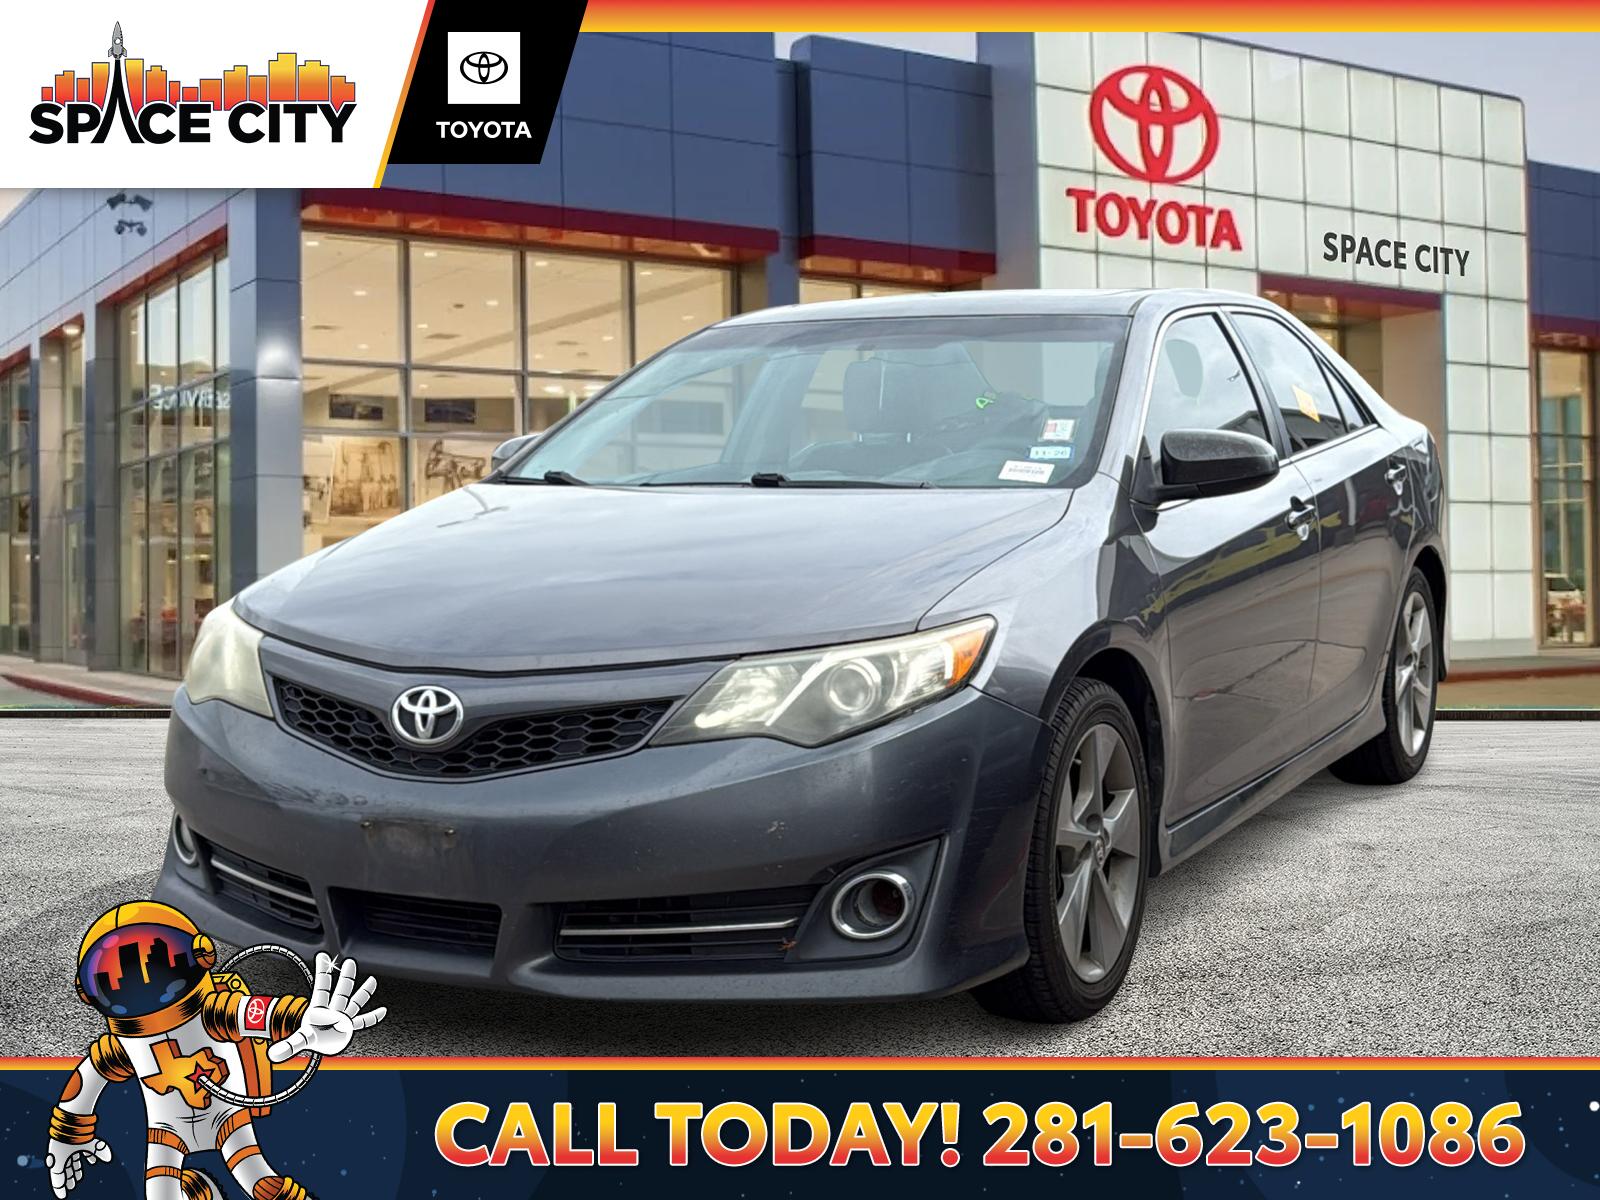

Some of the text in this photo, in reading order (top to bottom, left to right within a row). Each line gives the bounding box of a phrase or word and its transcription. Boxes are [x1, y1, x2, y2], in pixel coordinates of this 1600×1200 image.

[1066, 186, 1243, 252] TOYOTA
[1323, 232, 1470, 277] SPACE CITY
